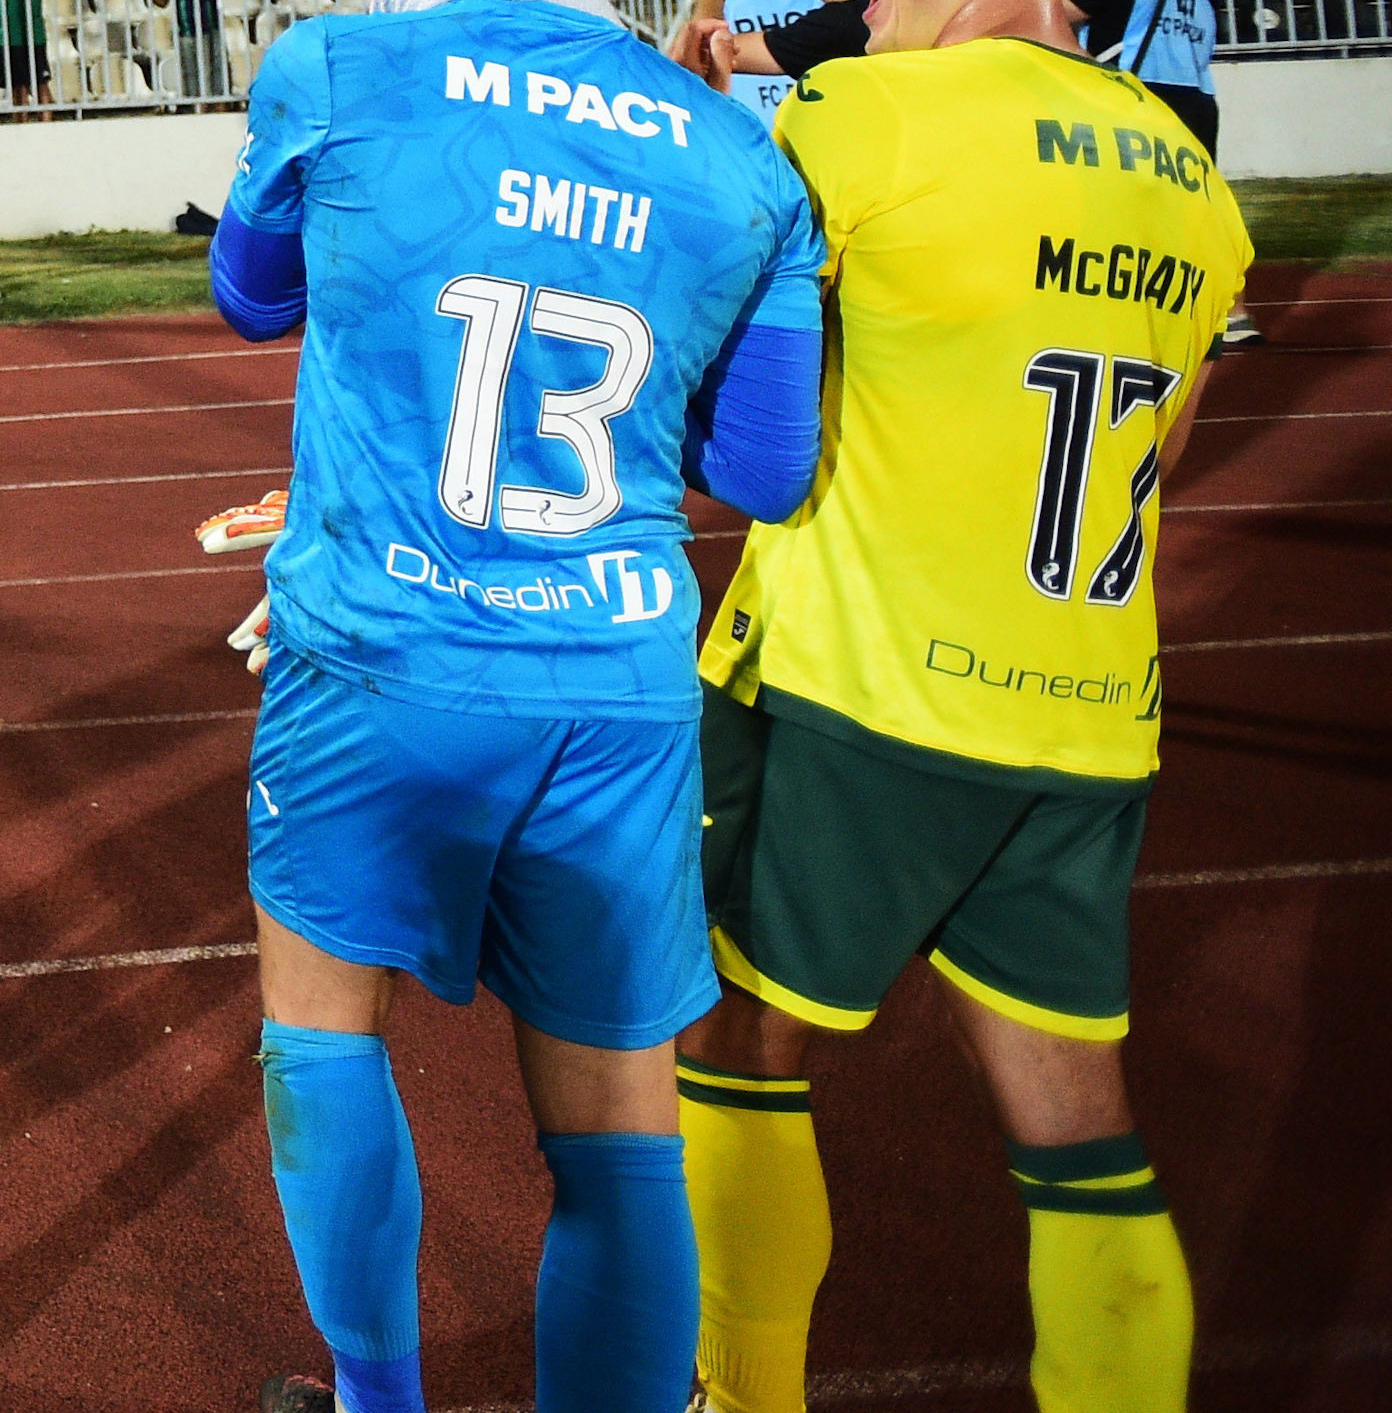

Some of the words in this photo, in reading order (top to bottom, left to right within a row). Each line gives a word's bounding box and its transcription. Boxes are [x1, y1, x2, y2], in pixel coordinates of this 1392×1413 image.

[526, 72, 692, 148] PACT
[1113, 127, 1211, 203] PACT
[496, 169, 652, 253] SMITH
[434, 274, 655, 538] 13
[1023, 347, 1183, 608] 17
[385, 542, 593, 613] Dunedin
[926, 638, 1132, 706] Dunedin
